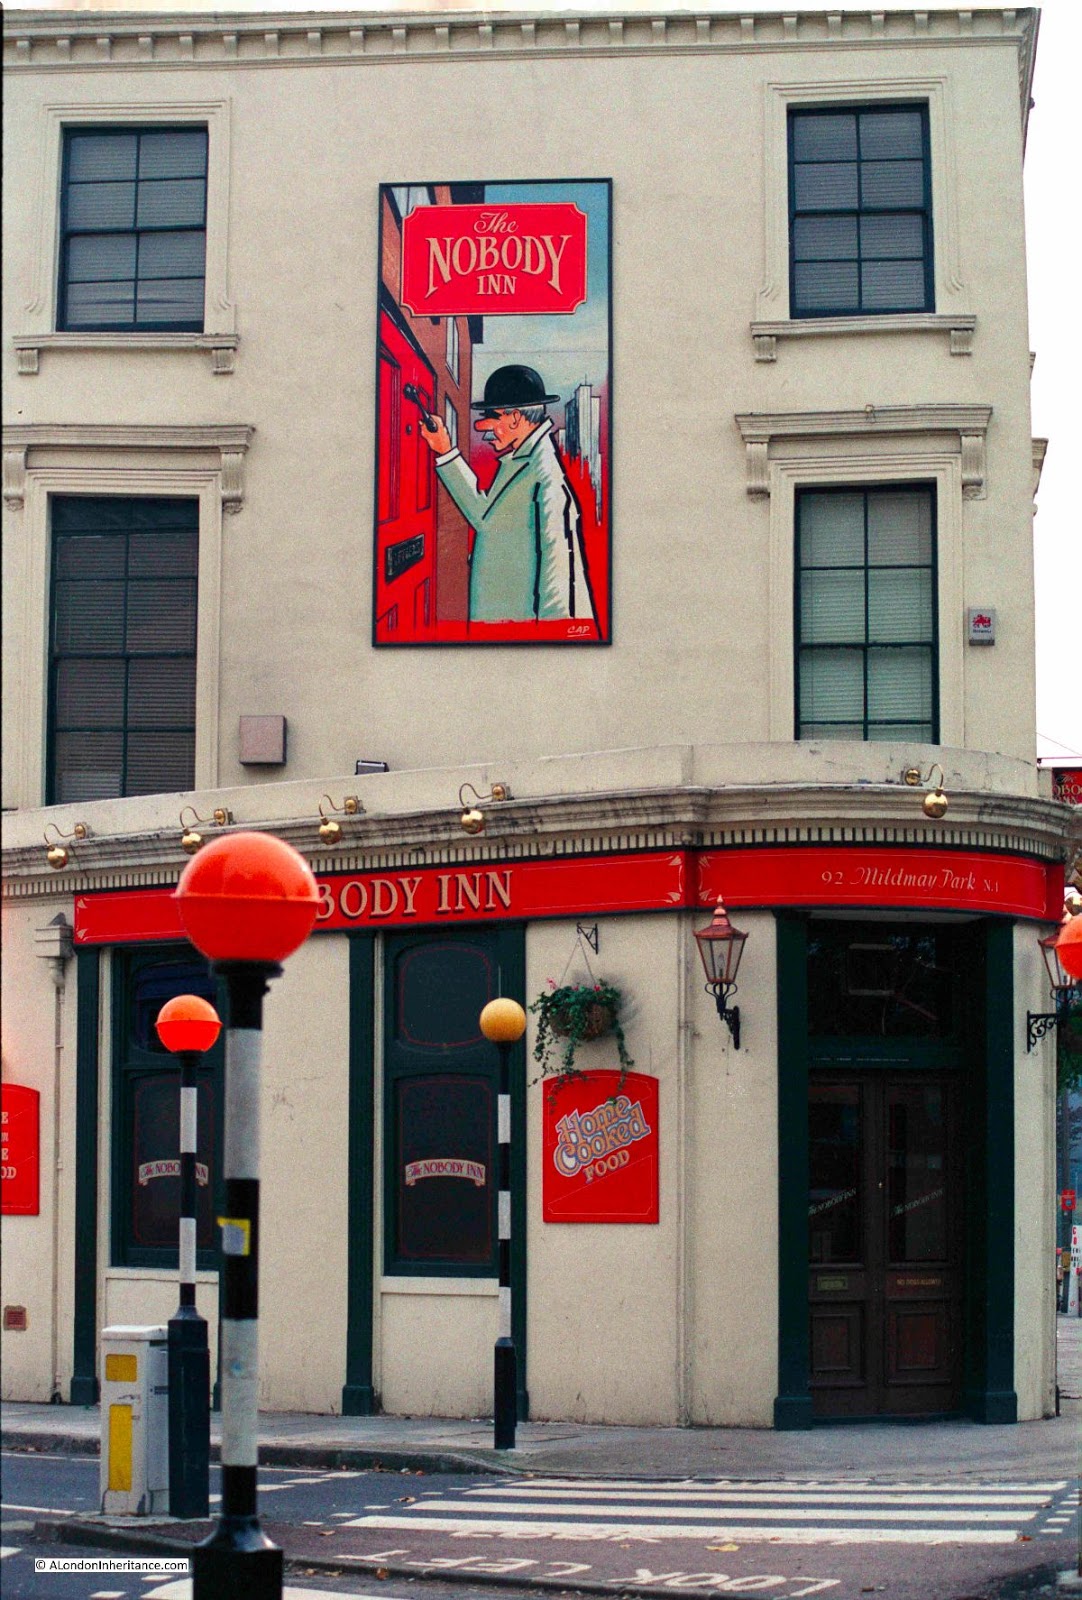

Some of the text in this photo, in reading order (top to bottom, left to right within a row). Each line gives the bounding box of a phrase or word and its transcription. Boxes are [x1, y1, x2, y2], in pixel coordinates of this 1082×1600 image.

[473, 212, 519, 234] The
[424, 234, 573, 299] NOBODY
[476, 274, 517, 295] INN
[316, 870, 513, 920] BODY INN
[821, 870, 844, 885] 92
[850, 867, 937, 892] Mildmay
[938, 869, 976, 890] Park
[555, 1095, 632, 1145] Home
[553, 1101, 652, 1177] Cooked
[155, 1161, 181, 1175] NOBO
[424, 1161, 465, 1175] NOBODY
[466, 1164, 484, 1178] INN
[582, 1150, 631, 1184] FOOD
[332, 1549, 843, 1597] LOOK LEFT
